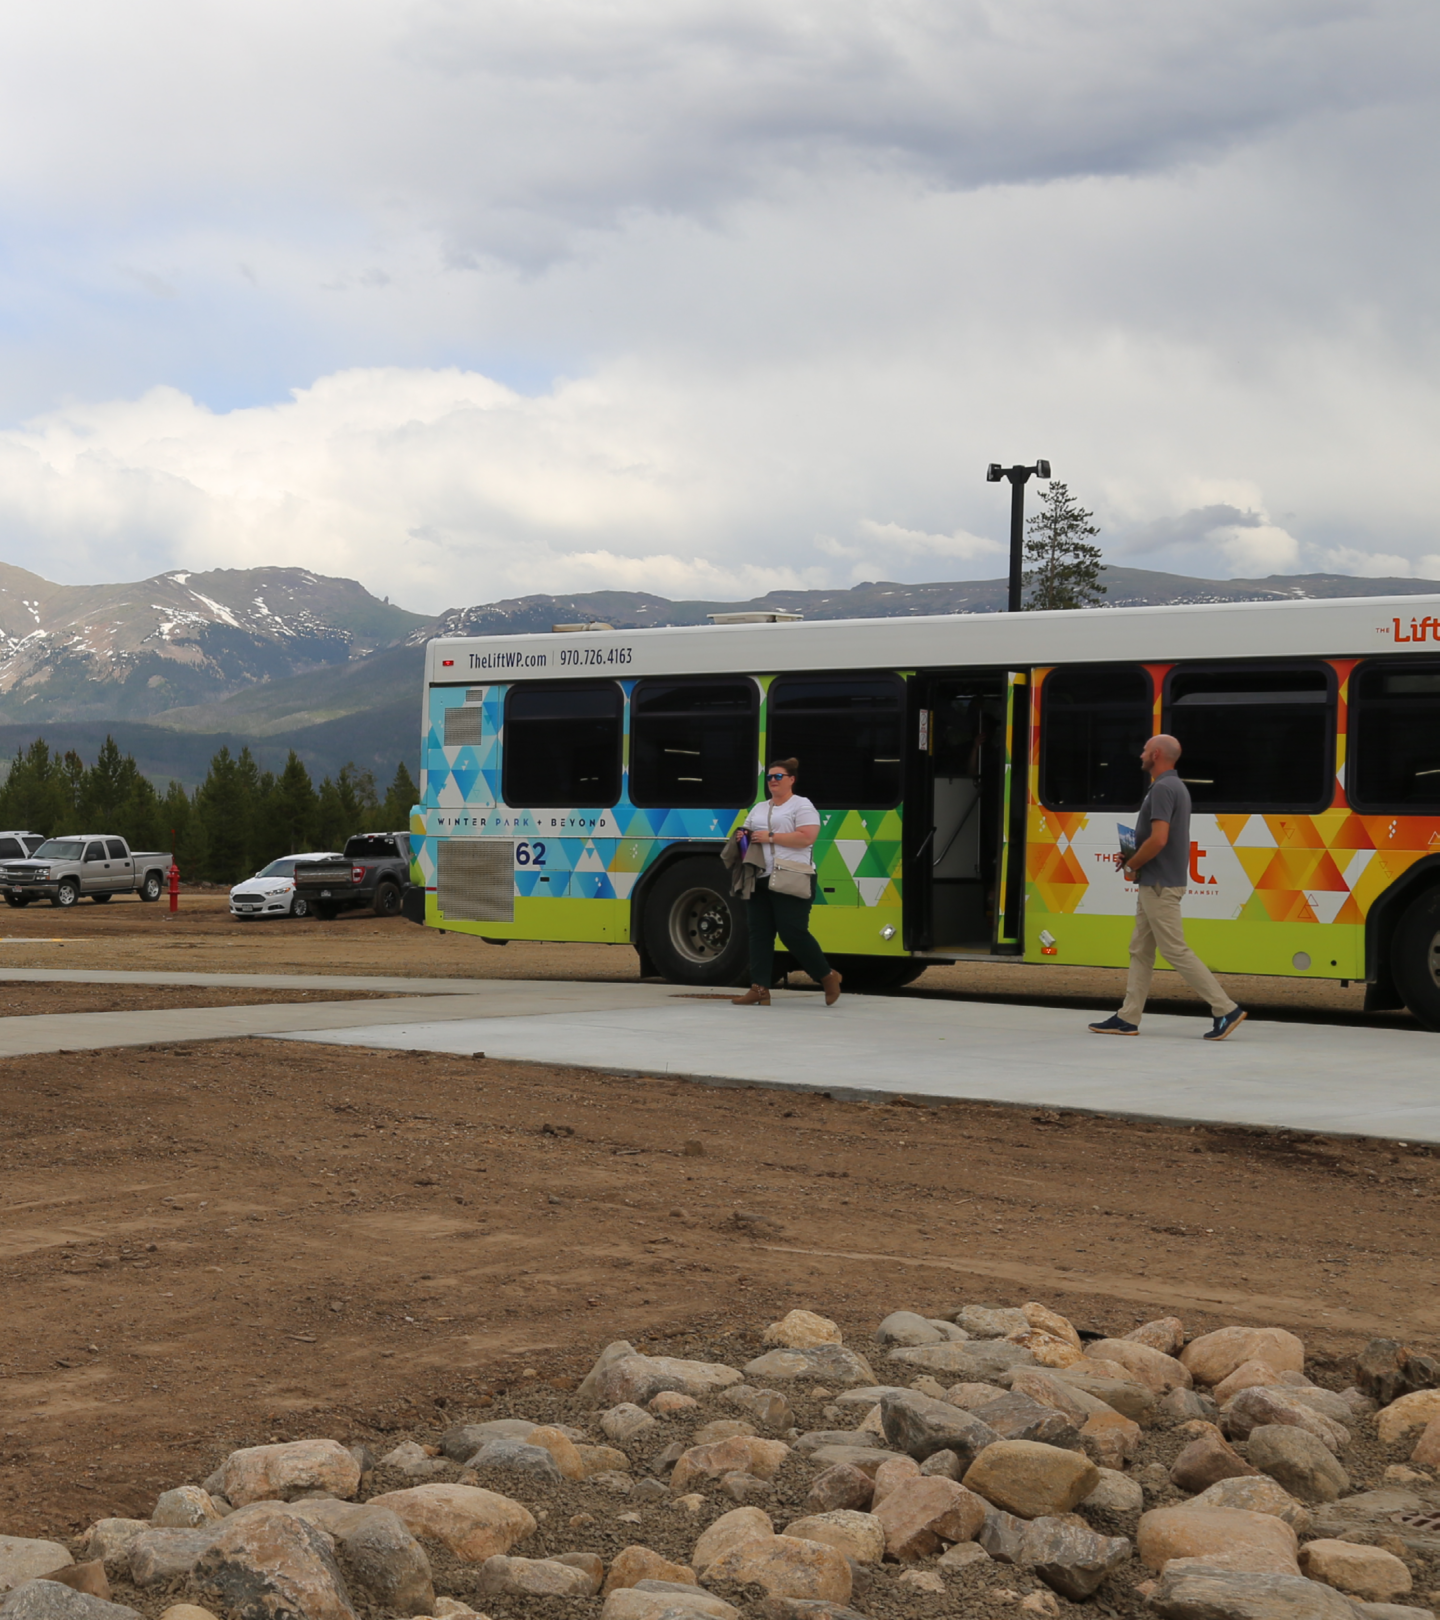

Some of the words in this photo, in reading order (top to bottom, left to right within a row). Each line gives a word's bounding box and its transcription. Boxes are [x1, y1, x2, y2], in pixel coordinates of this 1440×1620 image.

[1392, 616, 1440, 642] Lift
[469, 652, 547, 669] TheLiftWP.com
[560, 648, 632, 665] 970.726.4163
[438, 818, 486, 826] WINTER
[495, 818, 529, 826] PARK
[551, 818, 606, 827] BEYOND
[516, 842, 546, 866] 62
[1094, 853, 1119, 863] THE
